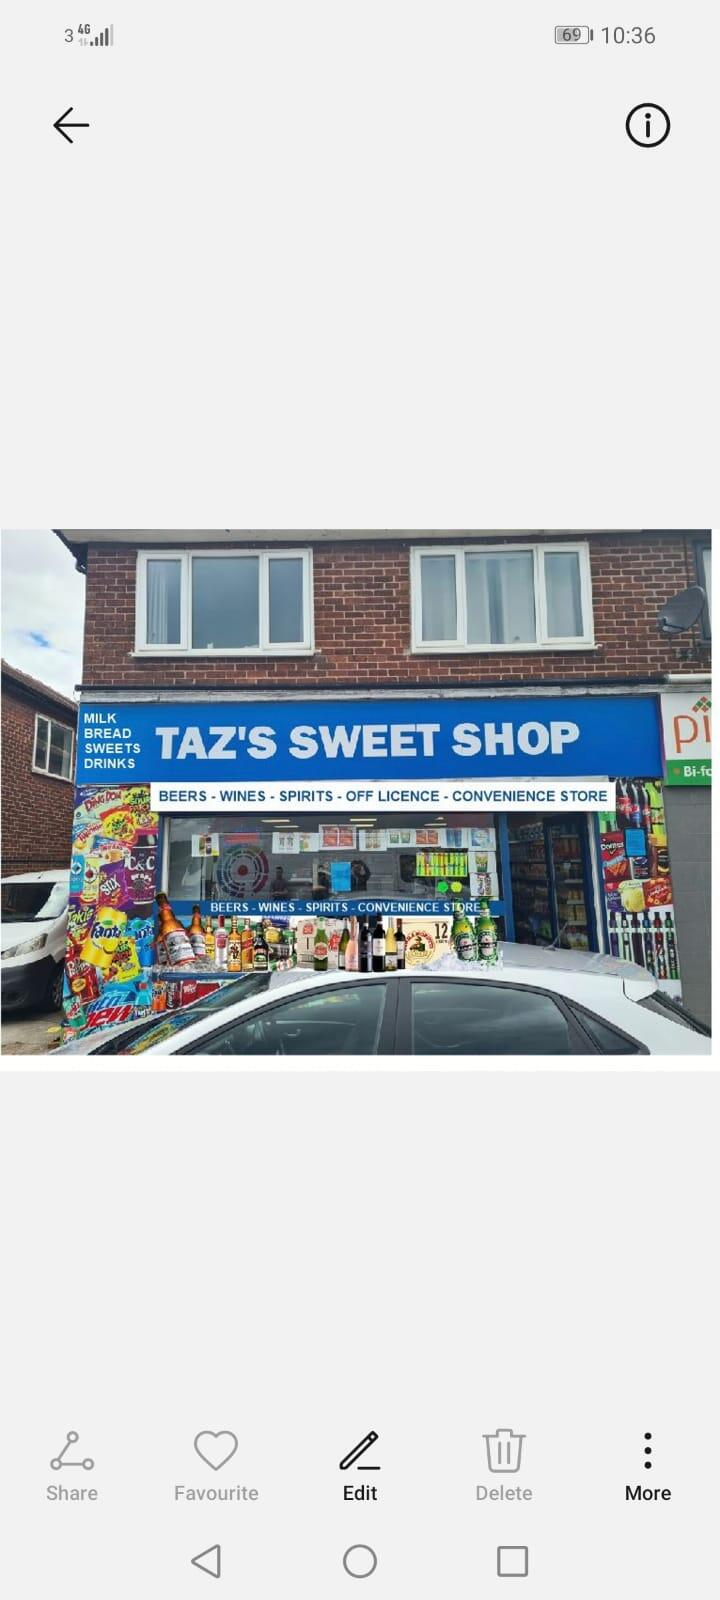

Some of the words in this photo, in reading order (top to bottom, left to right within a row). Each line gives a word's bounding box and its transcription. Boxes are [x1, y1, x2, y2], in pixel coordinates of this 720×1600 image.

[84, 713, 117, 724] MILK
[84, 728, 132, 739] BREAD
[155, 726, 277, 760] TAZ'S
[289, 724, 441, 759] SWEET
[452, 721, 580, 757] SHOP
[85, 743, 141, 754] SWEETS
[84, 758, 136, 769] DRINKS
[159, 790, 207, 802] BEERS
[219, 790, 266, 802] WINES
[279, 790, 333, 802] SPIRITS
[345, 790, 374, 802] OFF
[378, 790, 440, 802] LICENCE
[452, 790, 556, 802] CONVENIENCE
[560, 790, 608, 802] STORE
[210, 902, 249, 913] BEERS
[258, 902, 295, 913] WINES
[305, 902, 348, 913] SPIRITS
[358, 902, 440, 913] CONVENIENCE
[443, 902, 481, 913] STORE
[434, 922, 448, 940] 12
